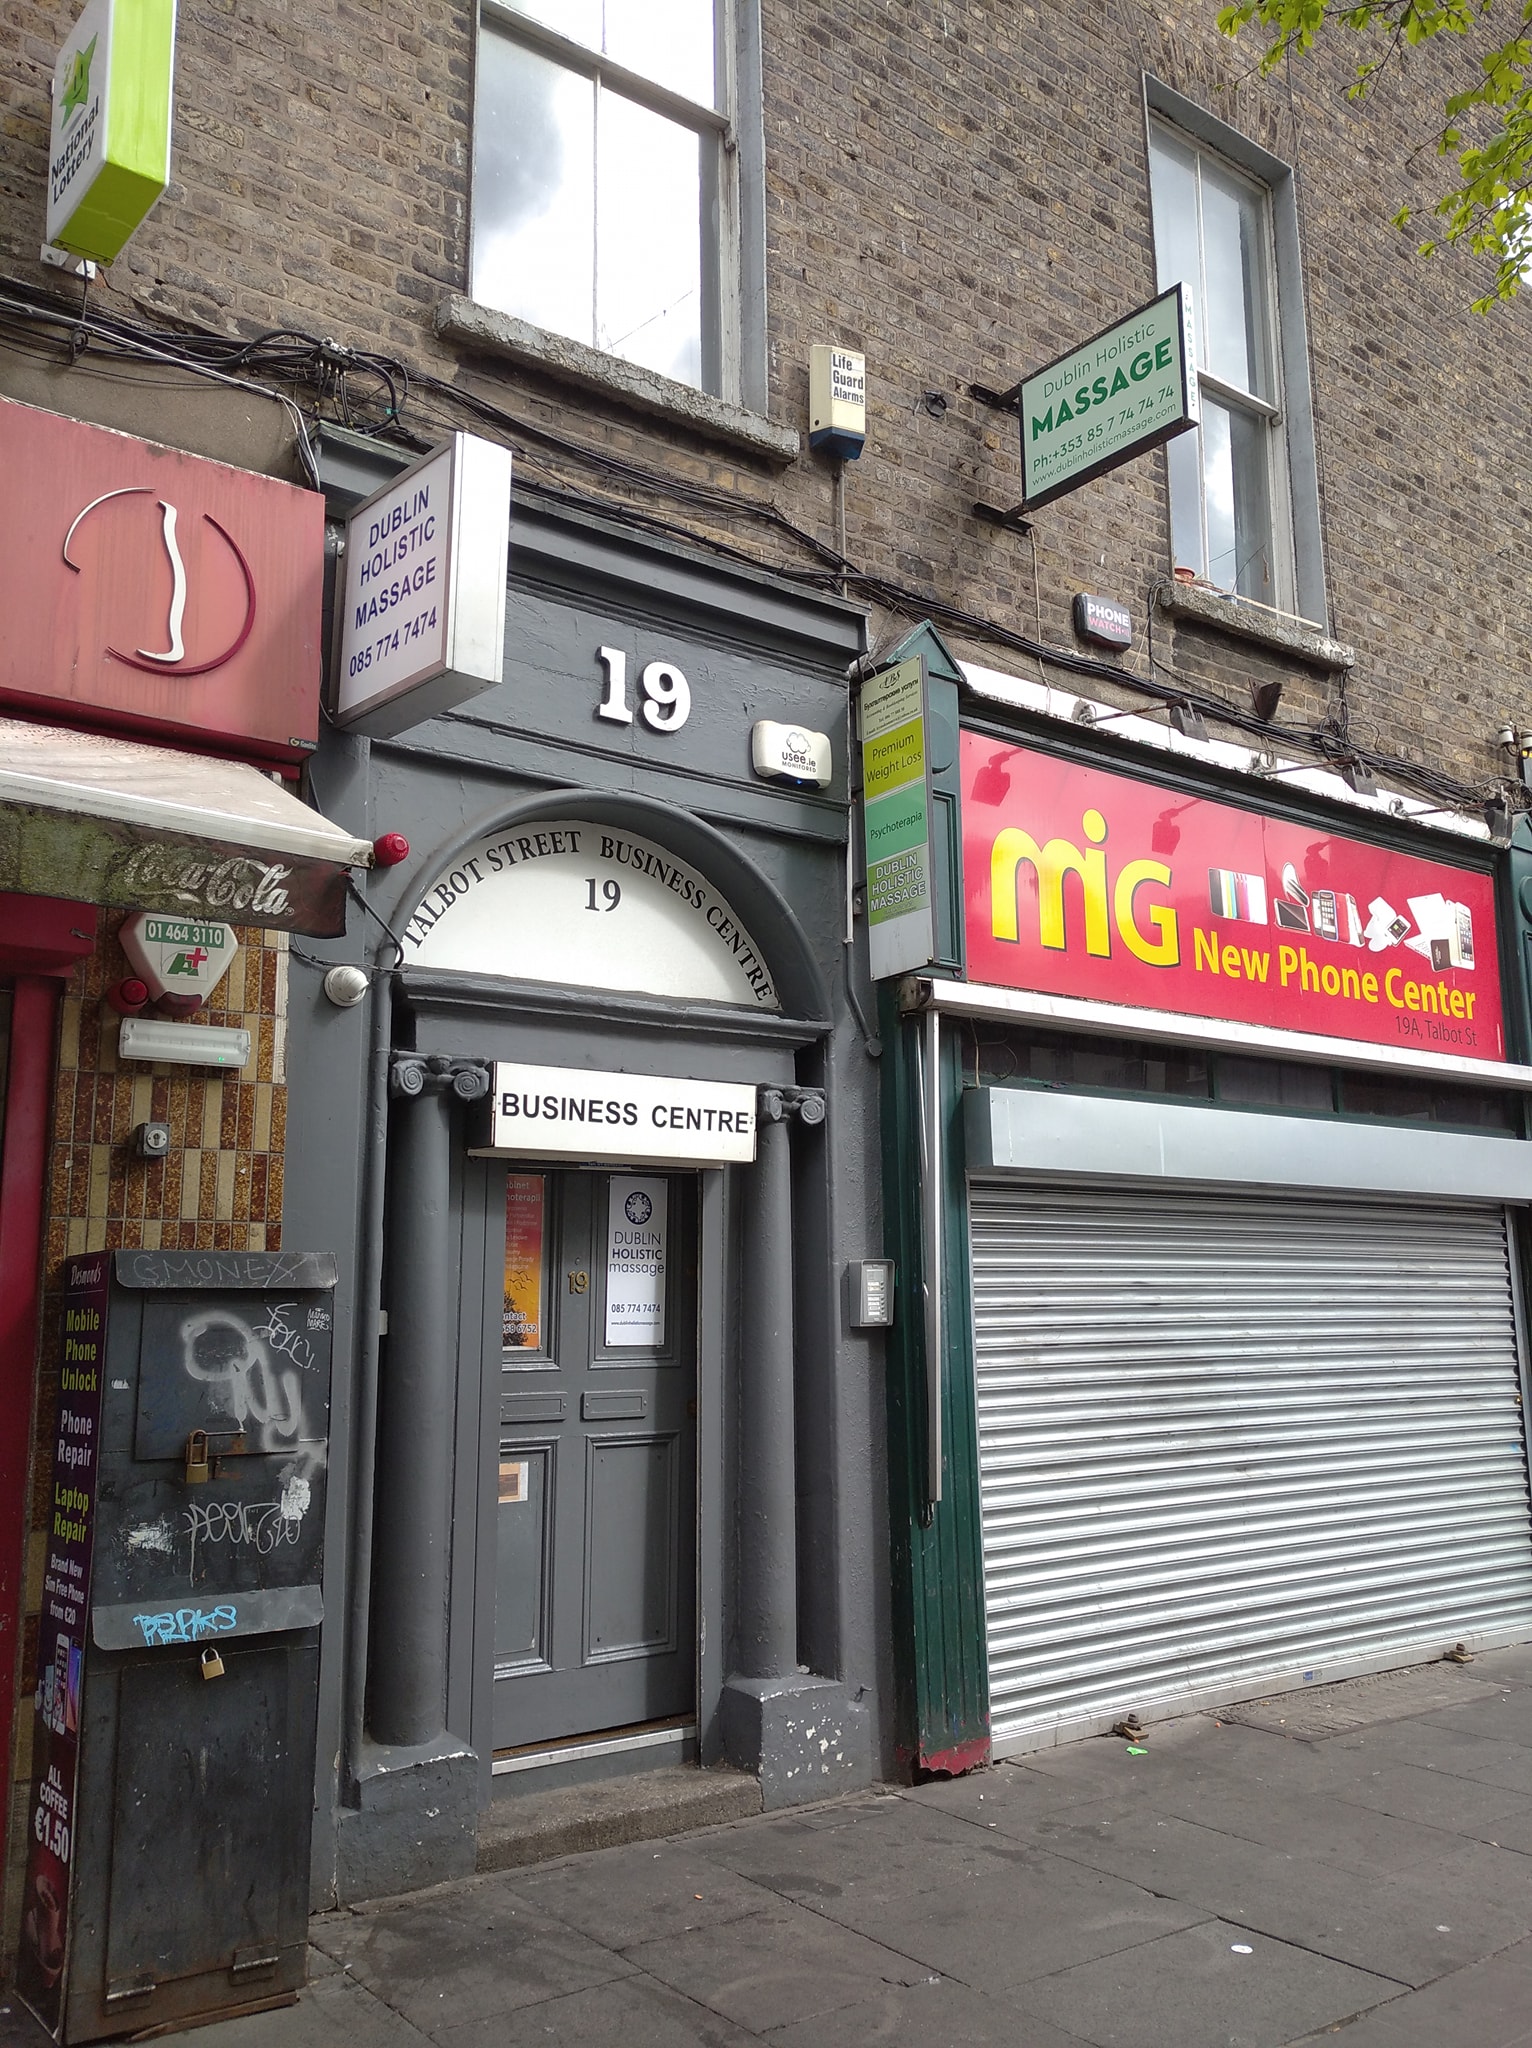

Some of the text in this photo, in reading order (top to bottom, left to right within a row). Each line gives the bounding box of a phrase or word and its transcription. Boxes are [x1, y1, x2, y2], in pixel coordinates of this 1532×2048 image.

[52, 95, 99, 185] National
[53, 129, 95, 205] Lottery
[832, 353, 853, 371] Life
[1043, 323, 1156, 398] Dublin Holistic
[1184, 302, 1196, 402] MASSAGE
[832, 369, 864, 390] Guard
[1032, 336, 1173, 441] MASSAGE
[833, 386, 864, 404] Alarms
[1033, 385, 1174, 472] Ph:+353 85 7 74 74 74
[1032, 403, 1177, 487] www.dublinholisticmassage.com
[369, 485, 430, 548] DUBLIN
[360, 515, 436, 587] HOLISTIC
[355, 557, 436, 630] MASSAGE
[1087, 602, 1129, 627] PHONE
[1088, 616, 1122, 635] WATCH
[350, 606, 437, 677] 085 774 7474
[596, 645, 692, 733] 19
[781, 751, 816, 767] usee.ie
[872, 734, 914, 761] Premium
[781, 760, 817, 773] MONITORED
[866, 751, 922, 783] Weight Loss
[870, 811, 923, 840] Psychoterapia
[876, 852, 917, 879] DUBLIN
[585, 878, 621, 912] 19
[872, 866, 923, 896] HOLISTIC
[870, 881, 926, 912] MASSAGE
[400, 831, 773, 1001] TALBOT STREET BUSINESS CENTRE
[148, 921, 222, 945] 01 464 3110
[1193, 927, 1476, 1020] New Phone Center
[1395, 1015, 1478, 1047] 19A, Talbot St
[501, 1092, 749, 1134] BUSINESS CENTRE
[506, 1180, 529, 1190] binet
[614, 1231, 661, 1245] DUBLIN
[612, 1248, 663, 1260] HOLISTIC
[567, 1270, 589, 1295] 19
[609, 1263, 665, 1277] massage
[66, 1309, 100, 1332] Mobile
[504, 1311, 526, 1320] ntact
[611, 1303, 661, 1313] 085 774 7474
[517, 1324, 537, 1334] 6752
[65, 1338, 97, 1361] Phone
[61, 1367, 97, 1392] Unlock
[61, 1409, 93, 1436] Phone
[57, 1438, 92, 1470] Repair
[55, 1481, 89, 1517] Laptop
[53, 1511, 87, 1545] Repair
[50, 1553, 83, 1579] Brand New
[45, 1575, 85, 1605] Sim Free Phone
[49, 1600, 76, 1626] from €20
[47, 1764, 62, 1791] ALL
[40, 1782, 68, 1820] COFFEE
[34, 1806, 69, 1864] €1.50
